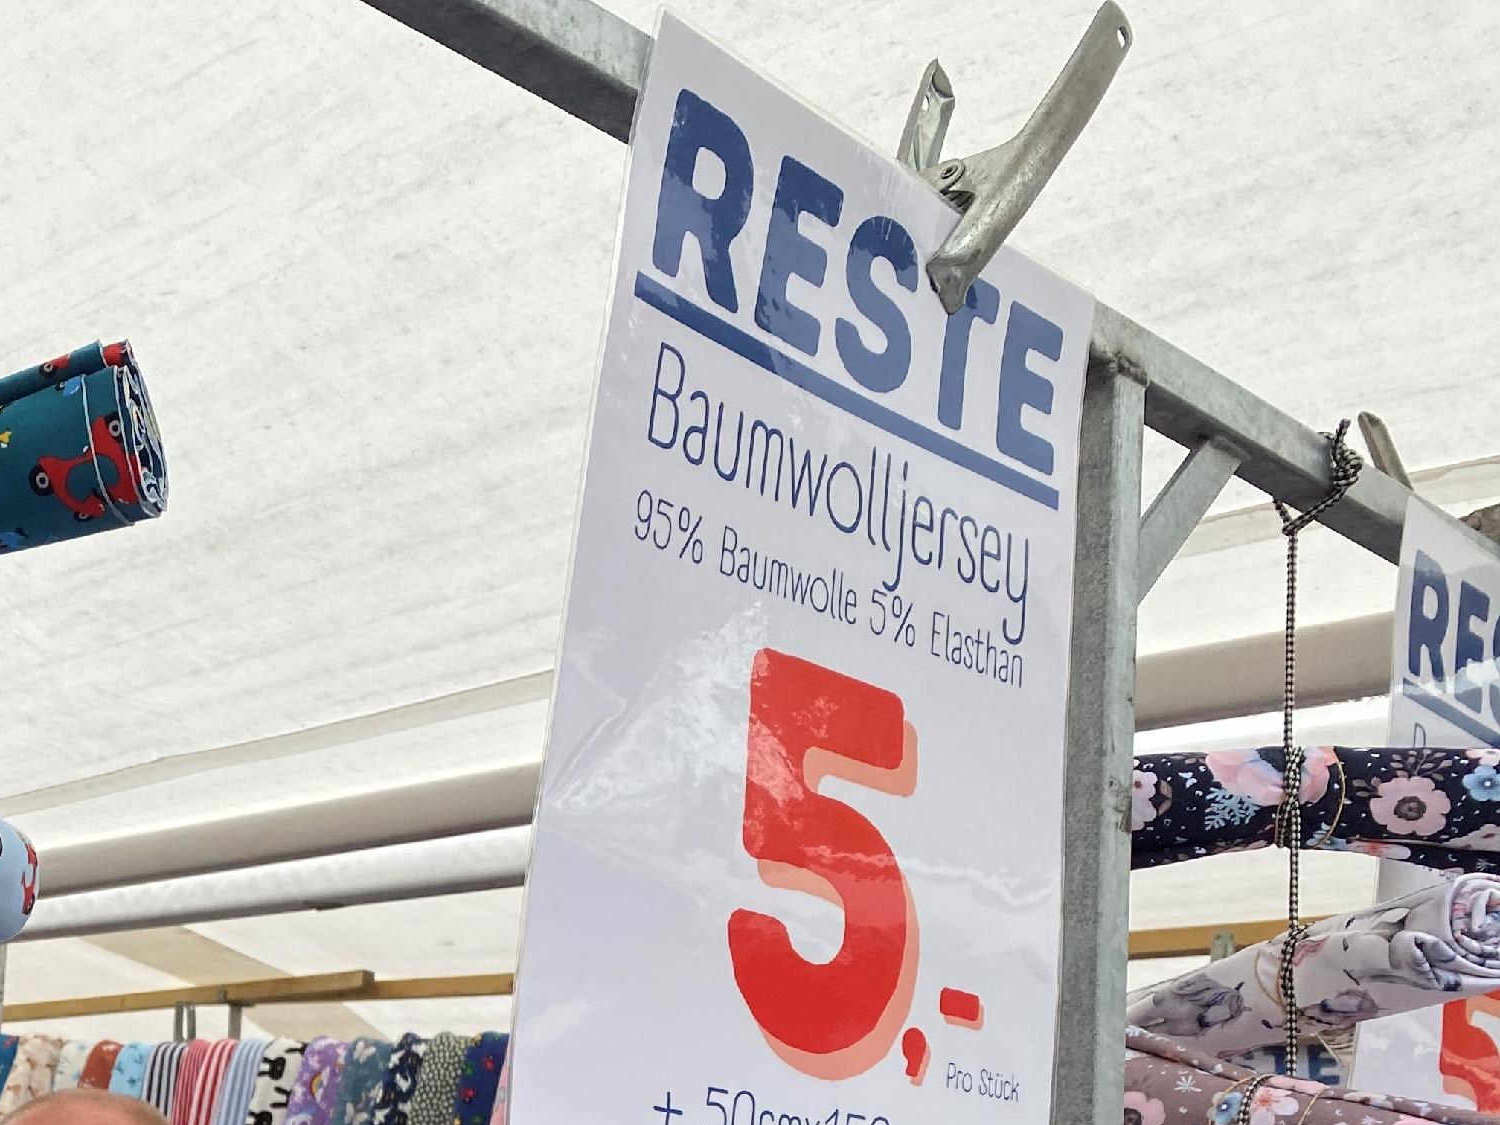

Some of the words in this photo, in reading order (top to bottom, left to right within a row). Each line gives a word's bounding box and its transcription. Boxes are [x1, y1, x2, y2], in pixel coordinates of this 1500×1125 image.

[652, 88, 1064, 476] RESTE
[634, 489, 704, 565] 95%
[719, 525, 858, 625] Baumwolle
[869, 587, 916, 648] 5%
[930, 611, 1023, 688] Elasthan
[647, 342, 1030, 645] Baumwolljersey
[1408, 549, 1500, 729] RE
[946, 1062, 974, 1094] Pro
[979, 1068, 1020, 1102] Stück
